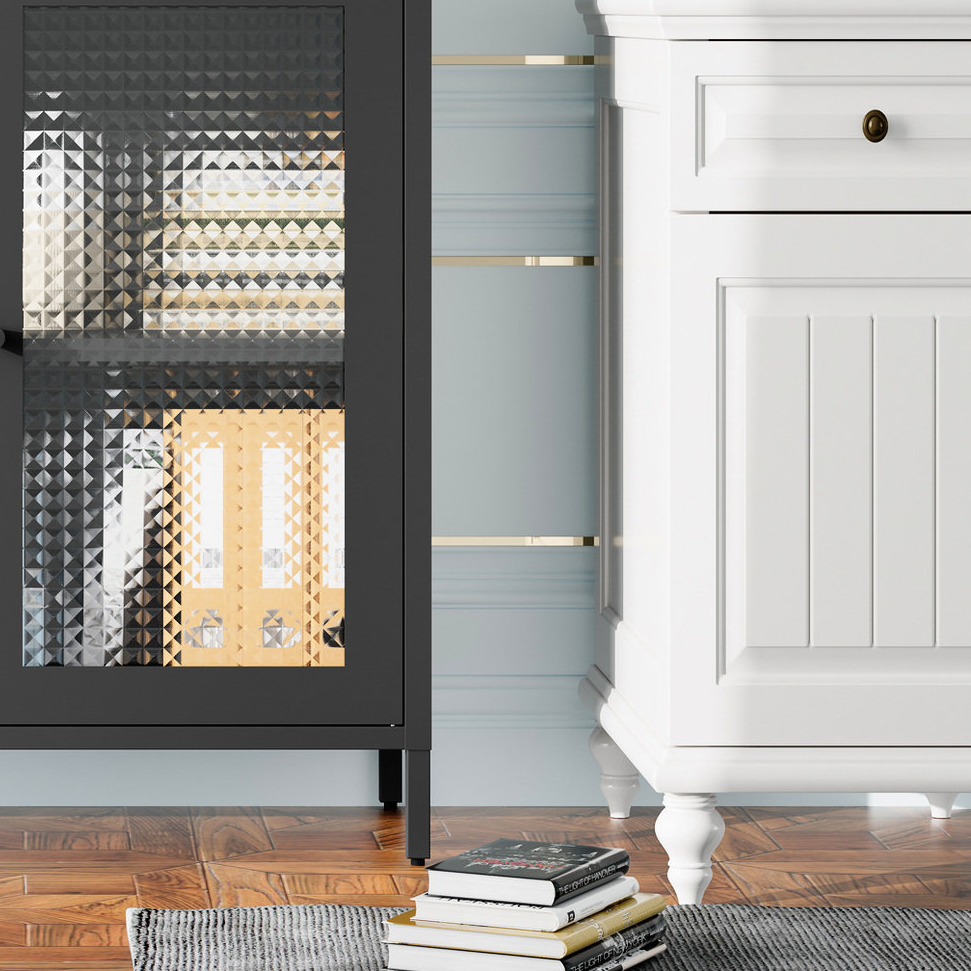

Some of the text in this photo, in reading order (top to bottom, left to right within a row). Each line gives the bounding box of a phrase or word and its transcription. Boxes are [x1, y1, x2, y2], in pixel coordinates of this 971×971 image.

[569, 877, 584, 892] LIGHT
[591, 865, 616, 881] HANOVER
[584, 953, 602, 969] LIGHT
[603, 949, 613, 960] OF
